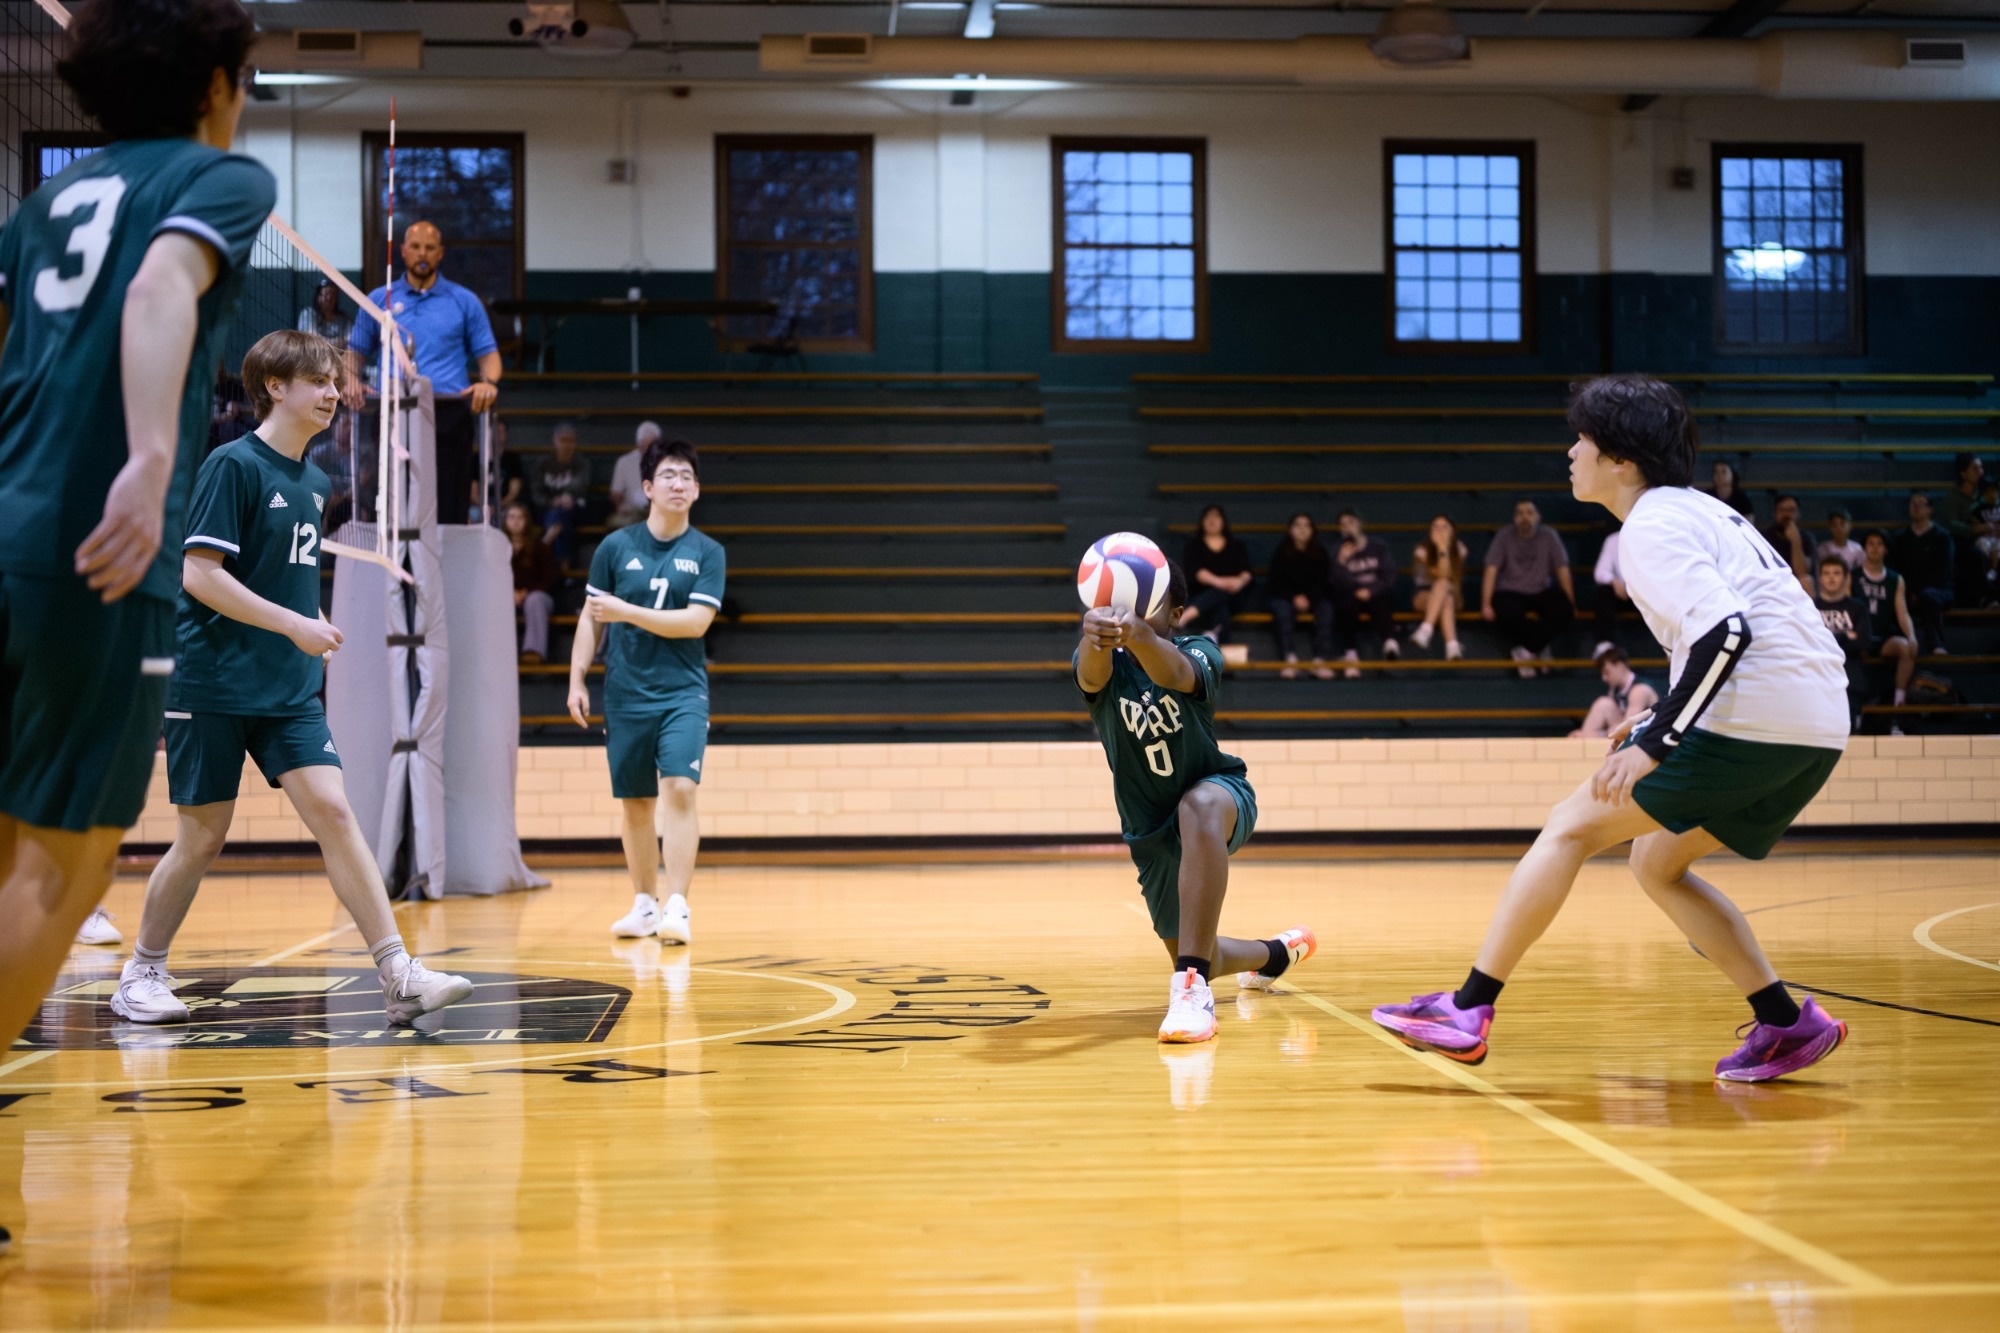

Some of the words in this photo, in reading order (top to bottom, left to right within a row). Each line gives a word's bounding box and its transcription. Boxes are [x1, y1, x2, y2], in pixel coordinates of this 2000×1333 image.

[34, 174, 127, 312] 3
[288, 522, 317, 567] 12
[649, 577, 669, 610] 7
[1144, 739, 1174, 777] 0
